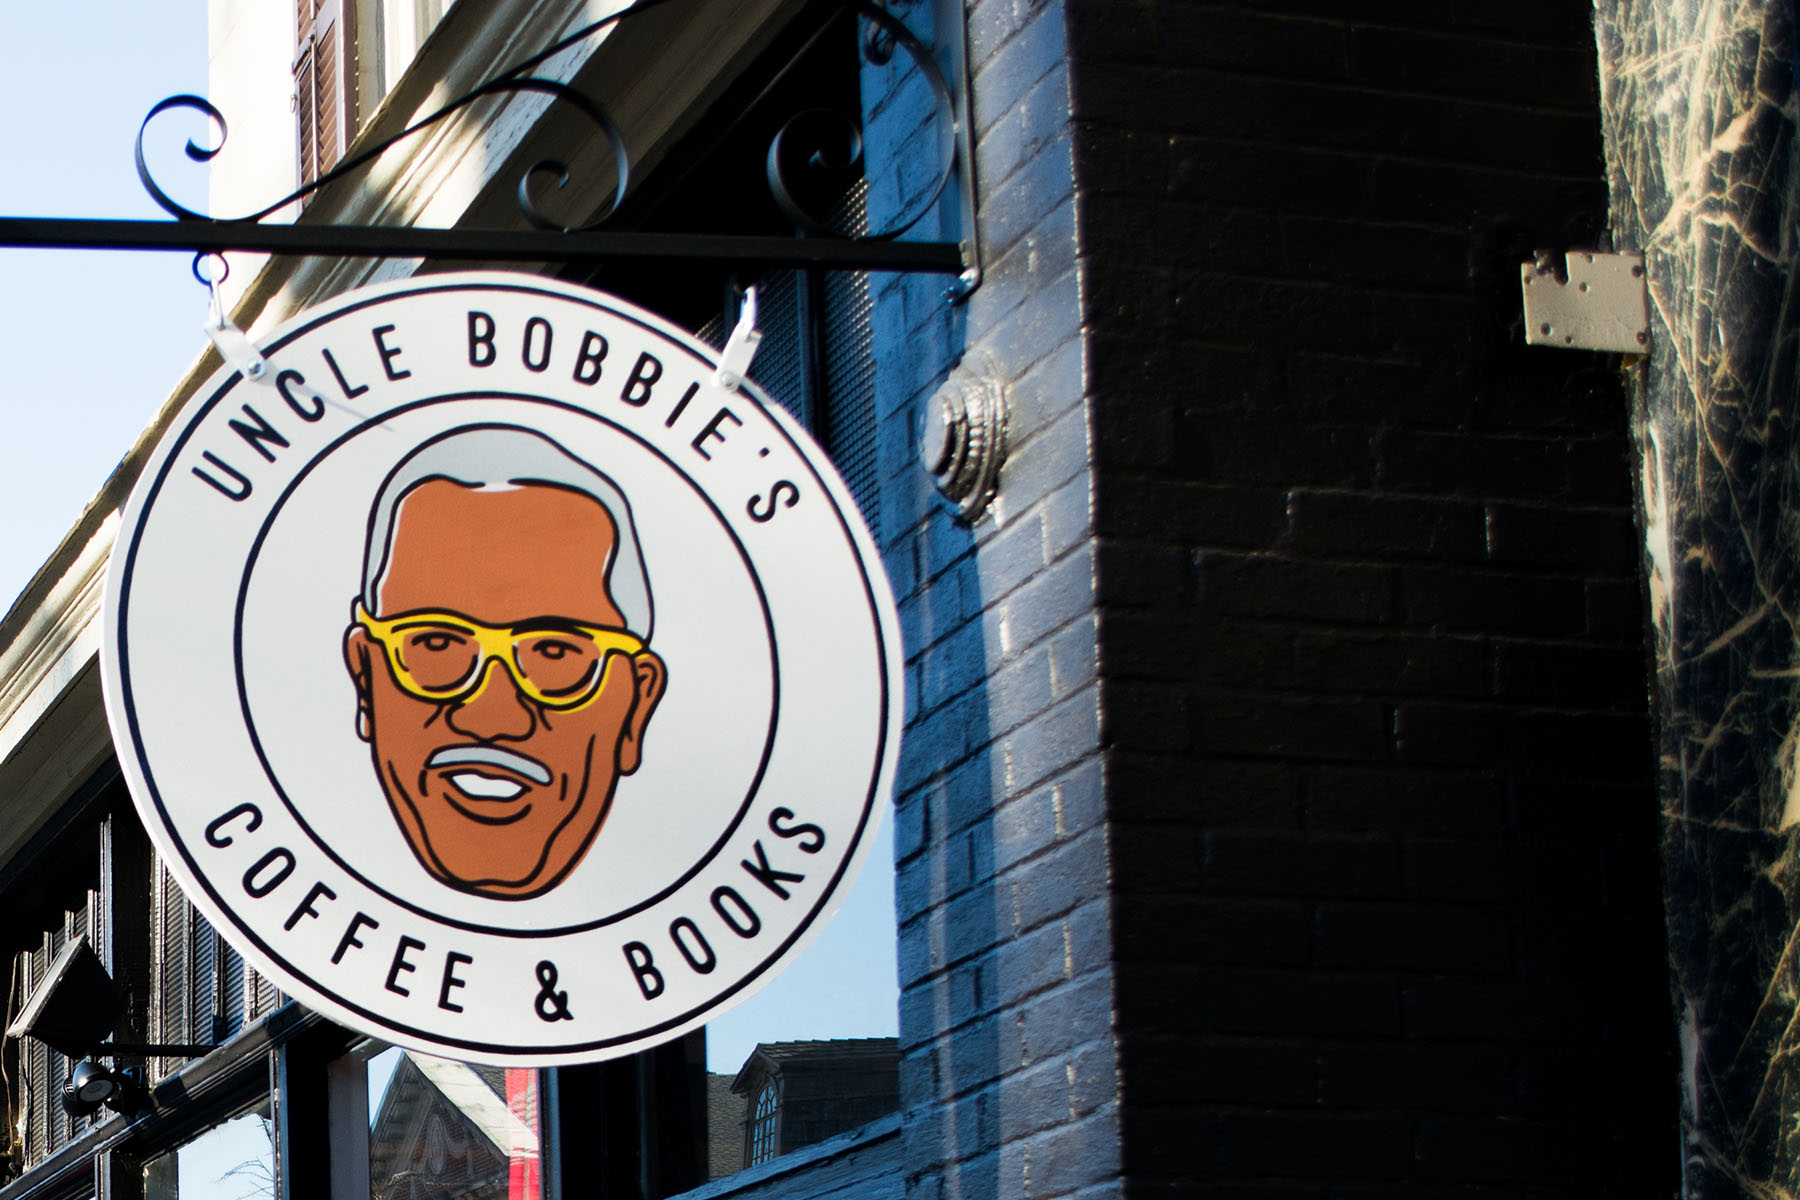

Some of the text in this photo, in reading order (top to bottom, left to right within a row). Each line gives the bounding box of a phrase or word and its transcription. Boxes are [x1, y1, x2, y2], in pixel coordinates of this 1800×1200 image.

[192, 311, 802, 524] UNCLE BOBBIE'S
[204, 802, 827, 1022] COFFEE & BOOKS
